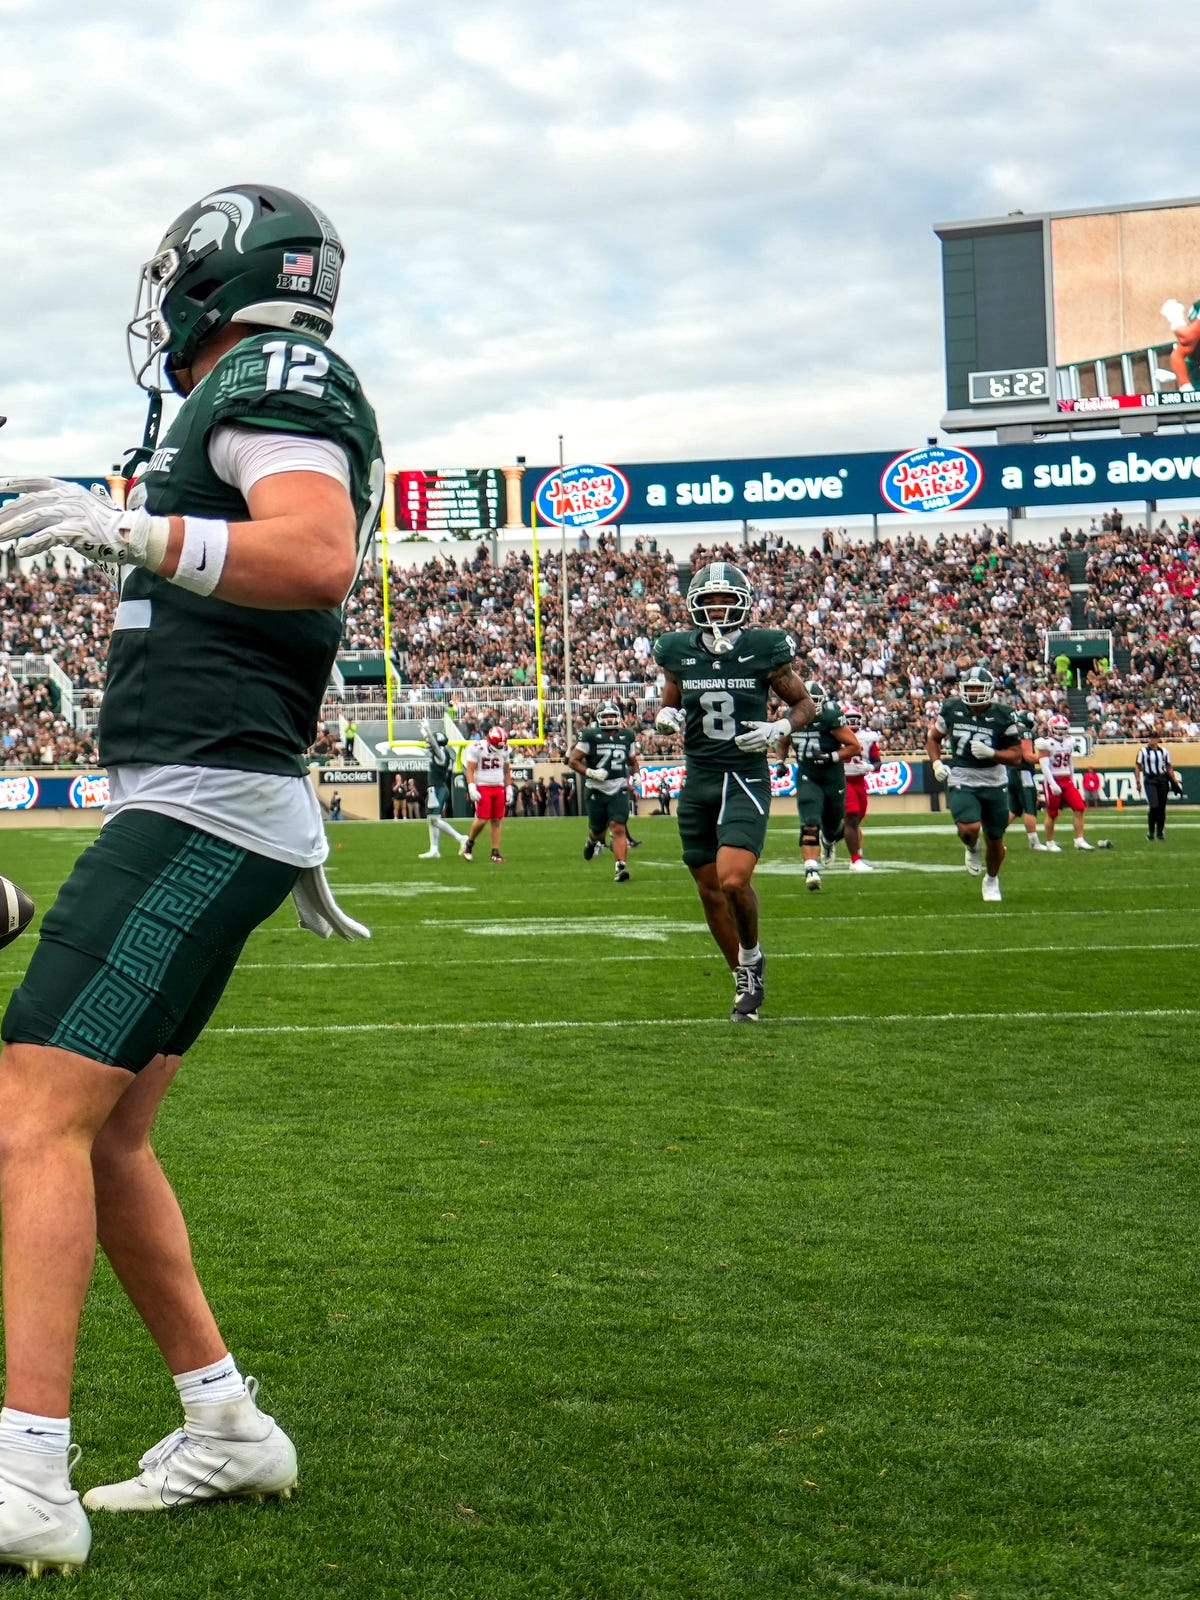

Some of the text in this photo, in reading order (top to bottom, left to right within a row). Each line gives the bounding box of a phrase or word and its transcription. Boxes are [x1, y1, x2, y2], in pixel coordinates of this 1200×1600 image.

[261, 339, 330, 399] 12
[989, 372, 1045, 398] 6:22
[147, 447, 181, 473] ATE
[895, 459, 965, 483] Jersey
[1001, 466, 1023, 490] a
[1033, 455, 1097, 488] sub
[547, 475, 613, 498] Jersey
[646, 483, 667, 507] a
[675, 474, 735, 506] sub
[682, 678, 757, 690] MICHIGAN STATE
[699, 690, 736, 740] 8
[595, 749, 626, 770] 72
[334, 771, 373, 782] Rocket
[510, 768, 528, 780] ket
